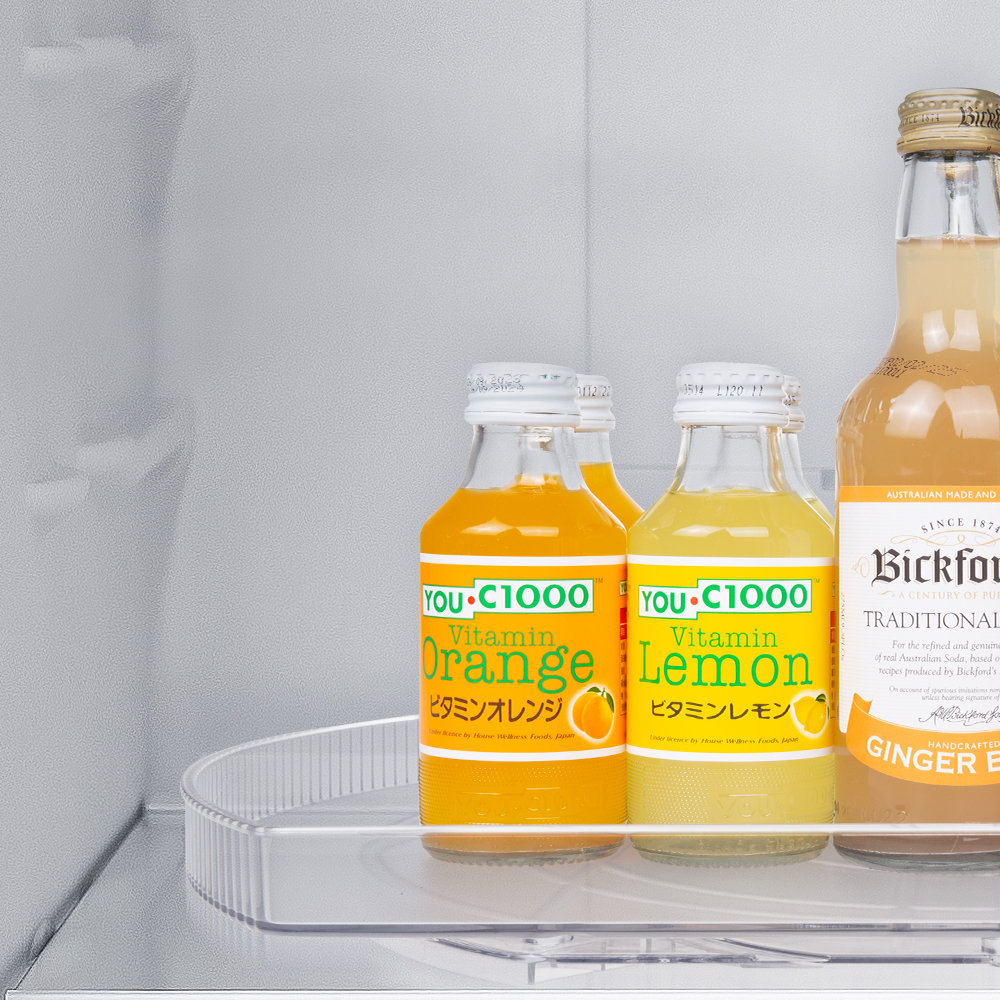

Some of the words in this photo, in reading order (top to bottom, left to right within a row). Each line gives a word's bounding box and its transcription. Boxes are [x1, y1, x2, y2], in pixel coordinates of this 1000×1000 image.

[887, 491, 942, 499] AUSTRALIAN
[921, 518, 963, 533] SINCE
[973, 518, 1000, 533] 1874
[907, 591, 958, 600] CENTURY
[961, 591, 977, 600] OF
[449, 625, 555, 646] Vitamin
[671, 627, 778, 647] Vitamin
[892, 640, 906, 649] For
[908, 641, 920, 650] the
[923, 641, 950, 650] refined
[953, 641, 968, 650] and
[423, 636, 593, 694] Orange
[639, 641, 812, 687] Lemon
[875, 653, 882, 662] of
[884, 654, 897, 662] real
[899, 654, 942, 662] Australian
[944, 654, 968, 664] Soda,
[970, 654, 992, 662] based
[879, 666, 903, 676] recipes
[905, 666, 942, 676] produced
[944, 665, 954, 677] by
[957, 666, 997, 676] Bickford's
[430, 695, 562, 722] ビタミンオレンジ
[652, 700, 790, 720] ビタミンレモン
[928, 741, 1000, 750] HANDCRAFTED
[867, 735, 976, 774] GINGER
